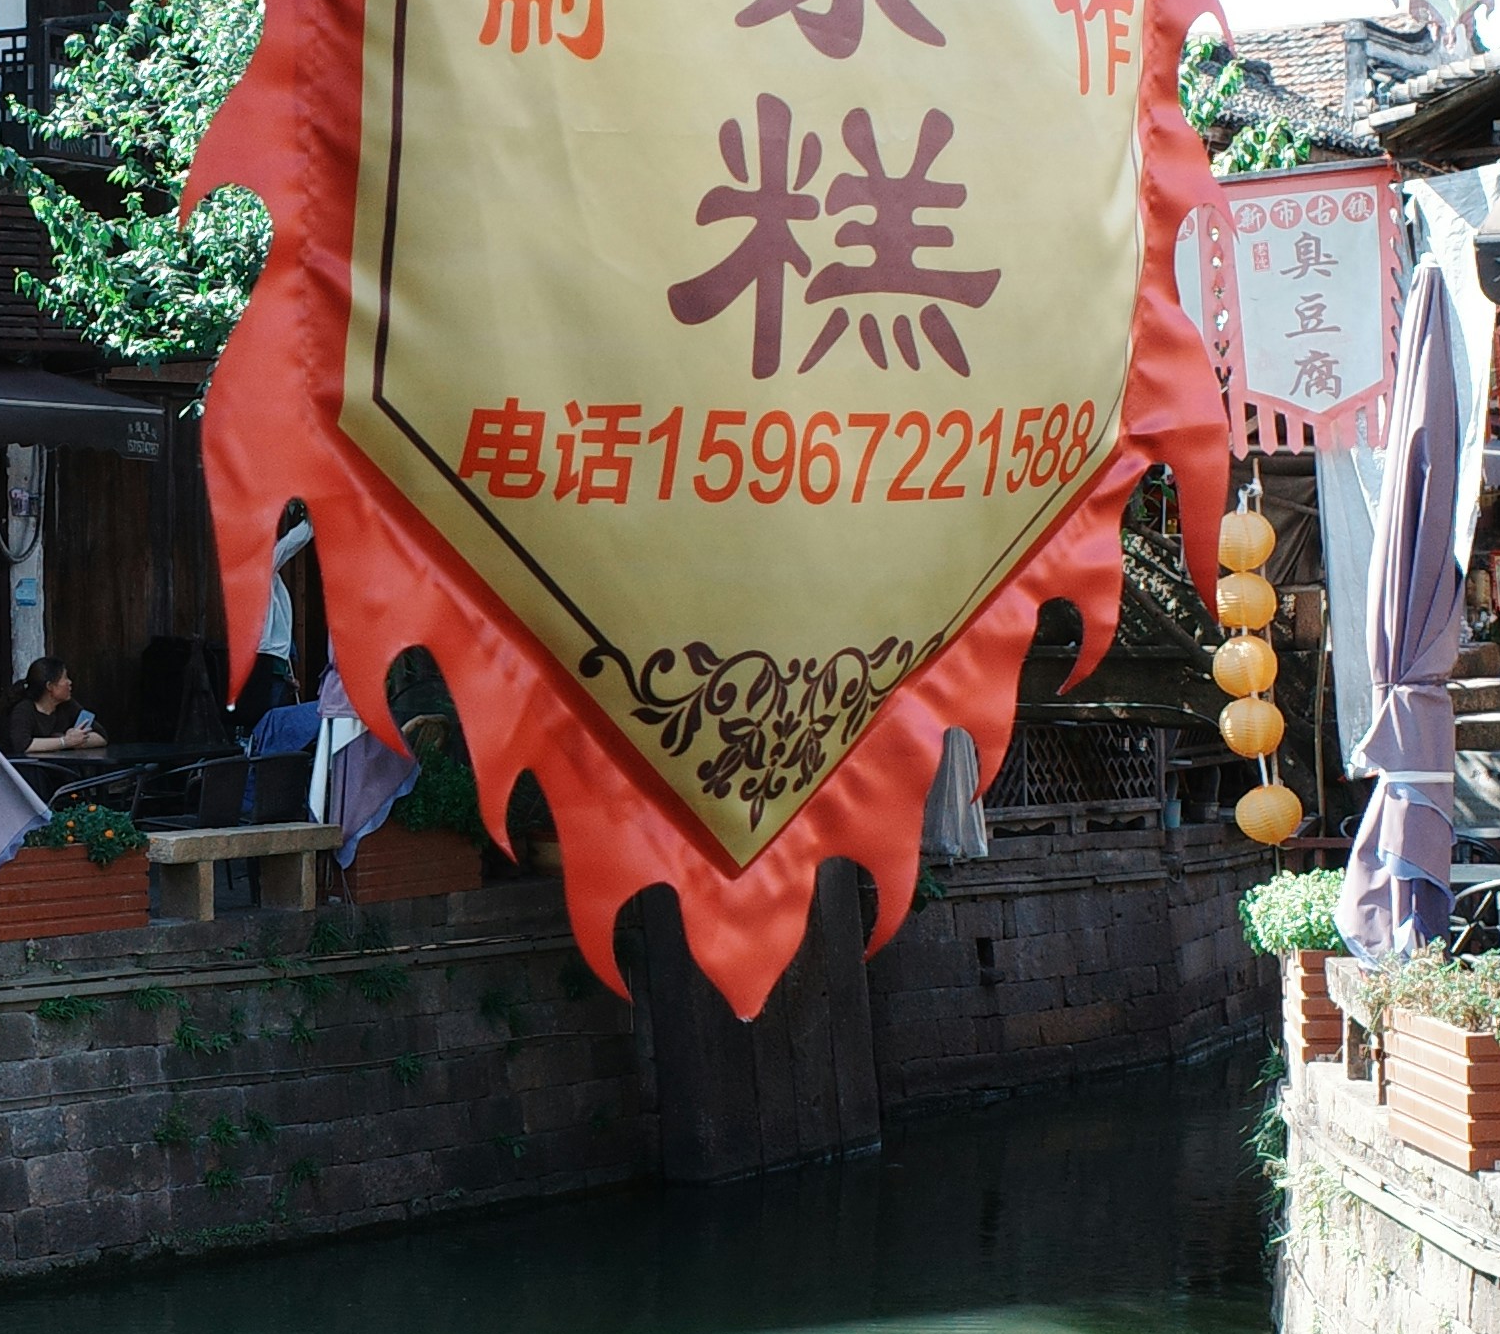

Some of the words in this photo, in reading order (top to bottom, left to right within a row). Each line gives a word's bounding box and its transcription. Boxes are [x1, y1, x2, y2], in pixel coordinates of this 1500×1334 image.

[1236, 191, 1377, 231] 新市古镇
[1280, 232, 1342, 399] 臭豆腐
[458, 396, 1097, 506] 电话15967221588
